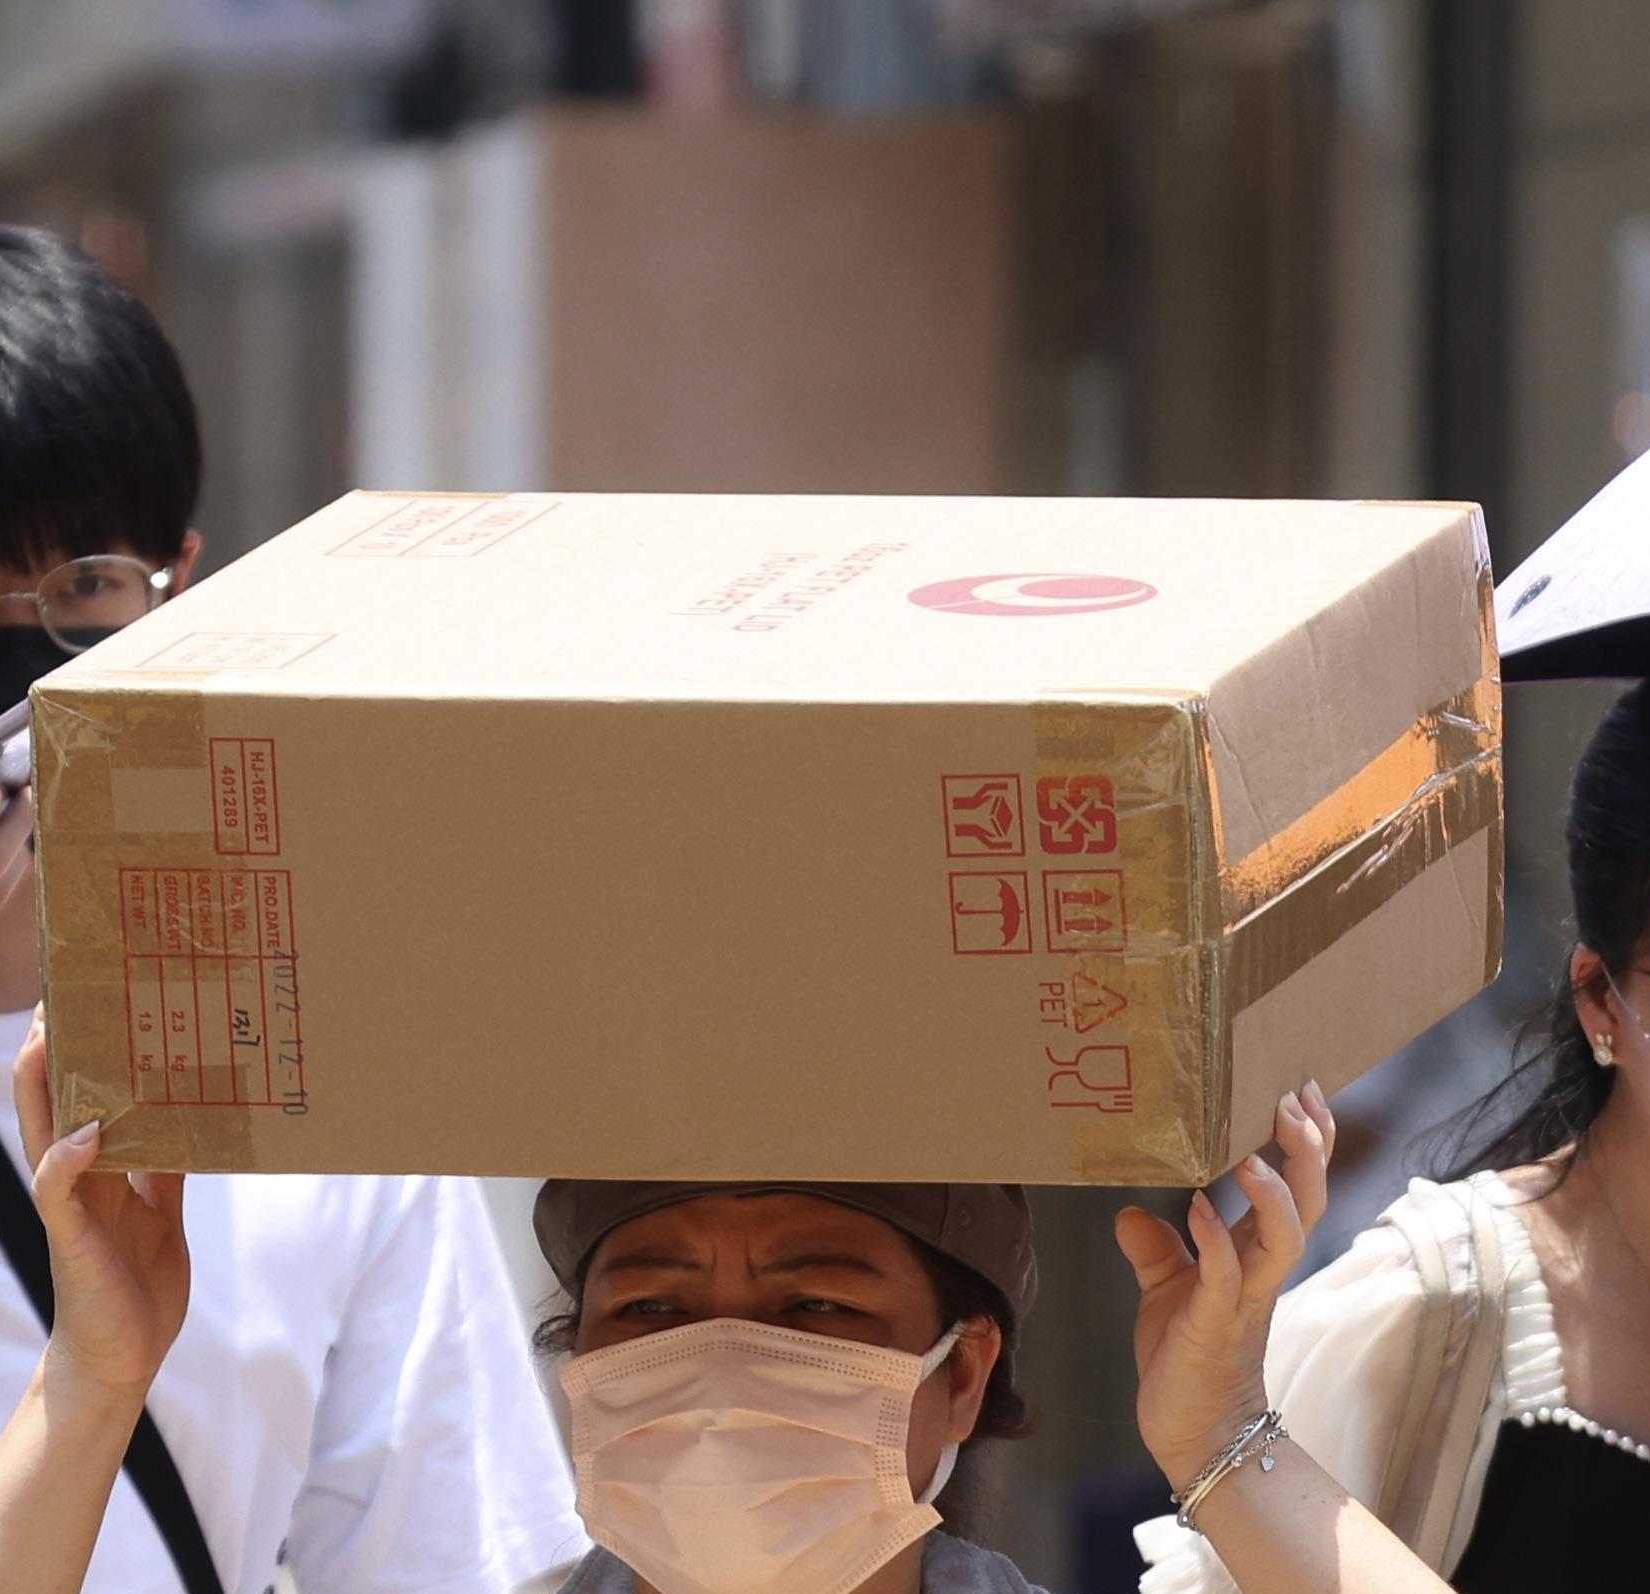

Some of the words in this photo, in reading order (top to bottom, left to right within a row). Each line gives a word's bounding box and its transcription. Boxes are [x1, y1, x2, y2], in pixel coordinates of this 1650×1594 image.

[220, 764, 239, 829] 401289
[249, 750, 271, 845] HJ-16X-PET
[260, 876, 281, 949] PRO.DATE
[138, 1011, 153, 1033] 1.9
[170, 1010, 186, 1033] 2.3
[1039, 982, 1068, 1028] PET
[273, 950, 309, 1117] 2022-12-10
[137, 1054, 154, 1073] kg
[170, 1054, 187, 1073] kg
